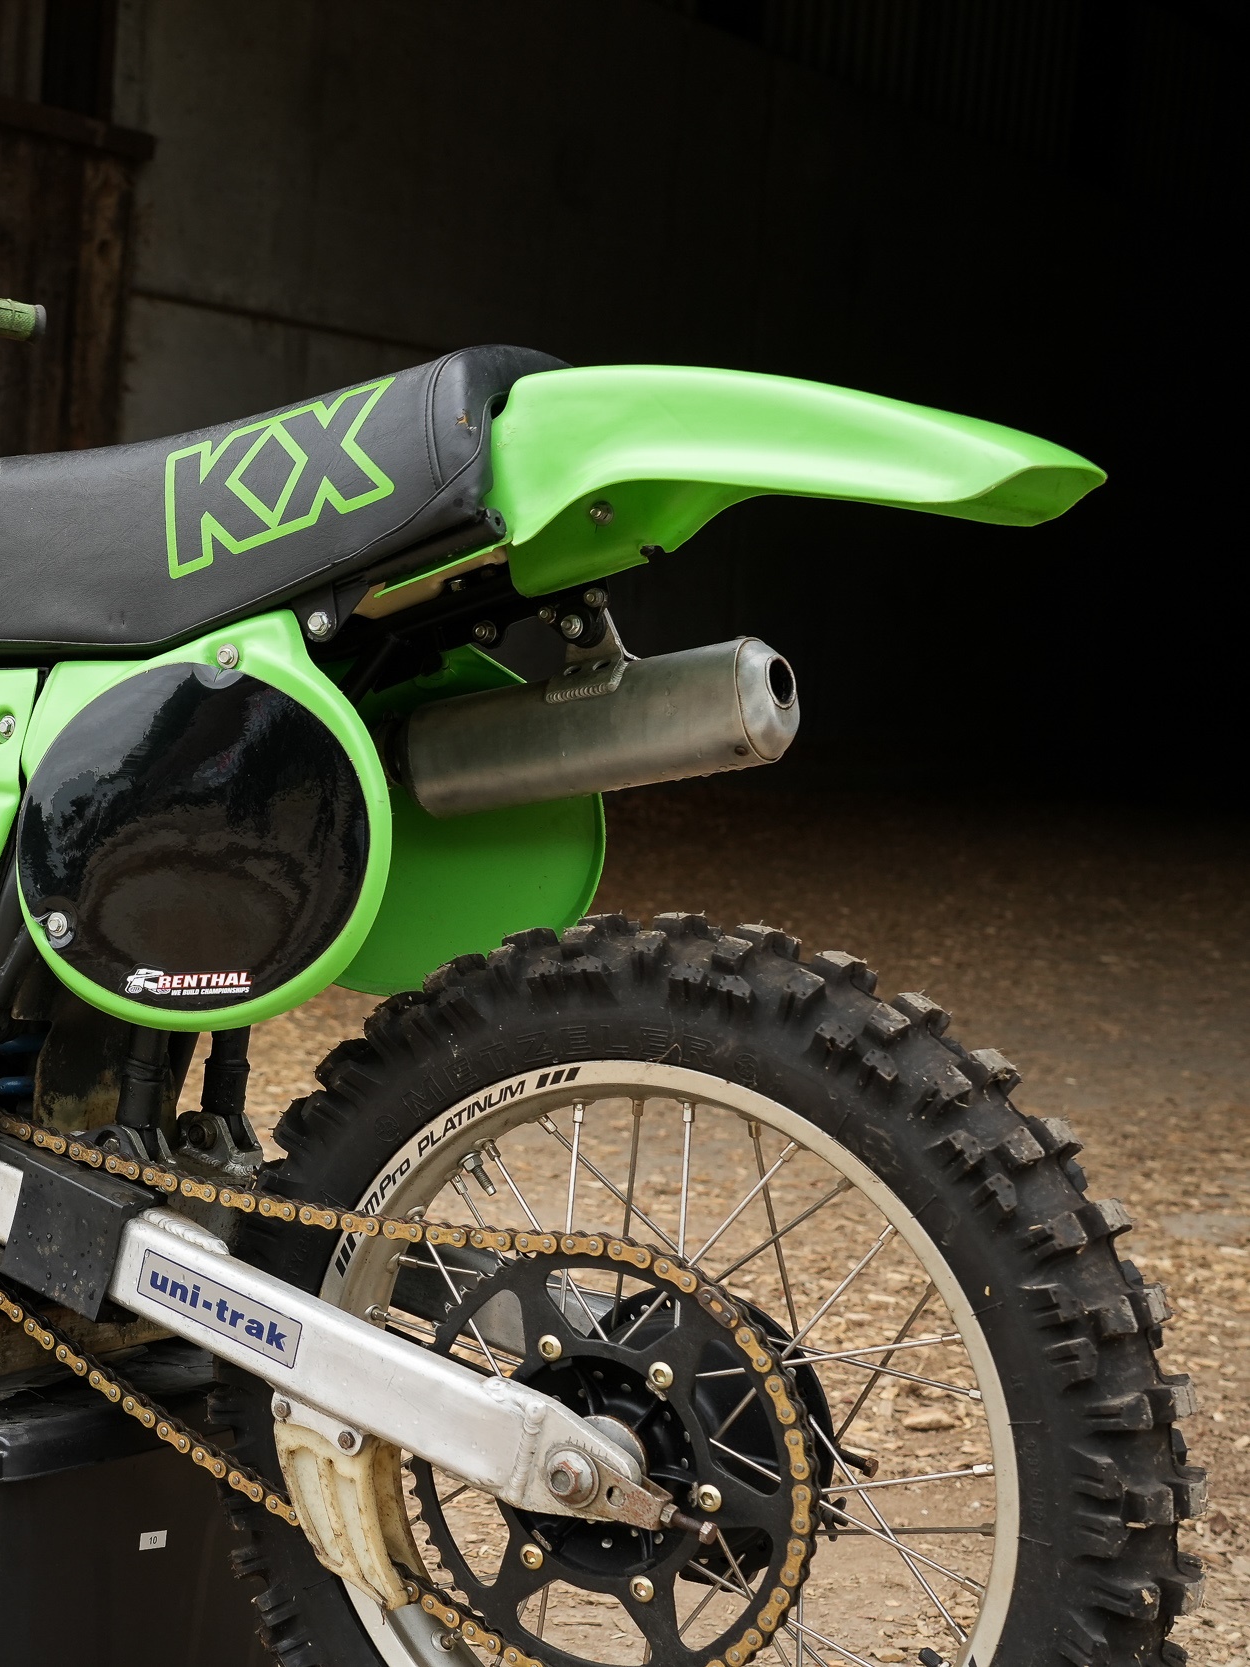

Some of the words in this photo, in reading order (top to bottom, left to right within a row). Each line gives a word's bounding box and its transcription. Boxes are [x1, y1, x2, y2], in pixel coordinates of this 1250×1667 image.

[164, 376, 396, 580] KX
[156, 971, 252, 989] RENTHAL
[170, 988, 182, 996] WE
[182, 988, 200, 996] BUILD
[200, 986, 250, 995] CHAMPIONSHIPS
[401, 1023, 717, 1119] METZELER
[417, 1079, 526, 1157] PLATINUM
[149, 1270, 288, 1352] uni-trak
[149, 1535, 158, 1545] 10
